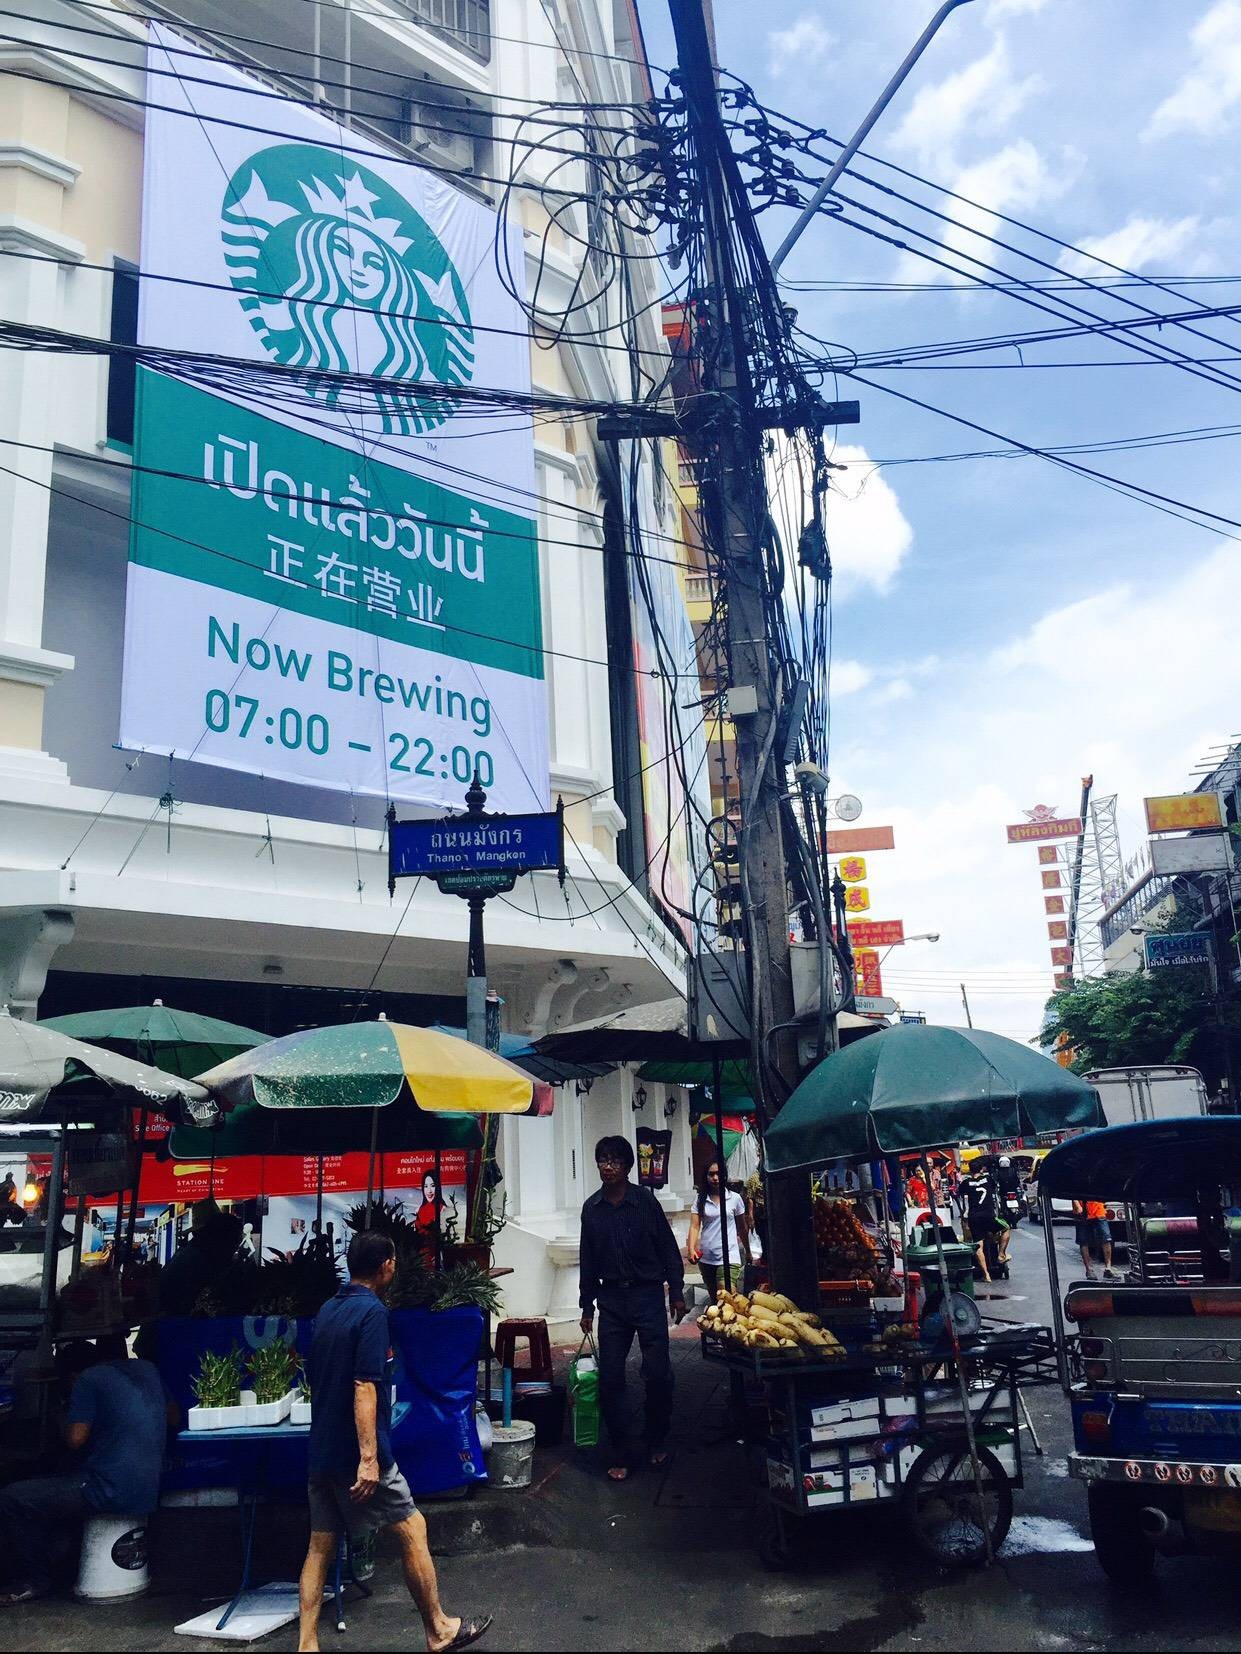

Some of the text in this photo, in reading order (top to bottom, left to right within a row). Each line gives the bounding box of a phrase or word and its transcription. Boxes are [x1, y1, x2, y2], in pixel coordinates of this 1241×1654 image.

[203, 433, 489, 583] เปิดแล้ววันนี้
[263, 533, 448, 632] 正在营业
[208, 615, 491, 737] Now Brewing
[205, 689, 330, 755] 07:00
[389, 732, 495, 788] 22:00
[431, 823, 523, 849] ถนนมังกร
[135, 1123, 170, 1132] Se Office
[176, 1179, 208, 1187] STATION
[975, 1187, 987, 1205] 7
